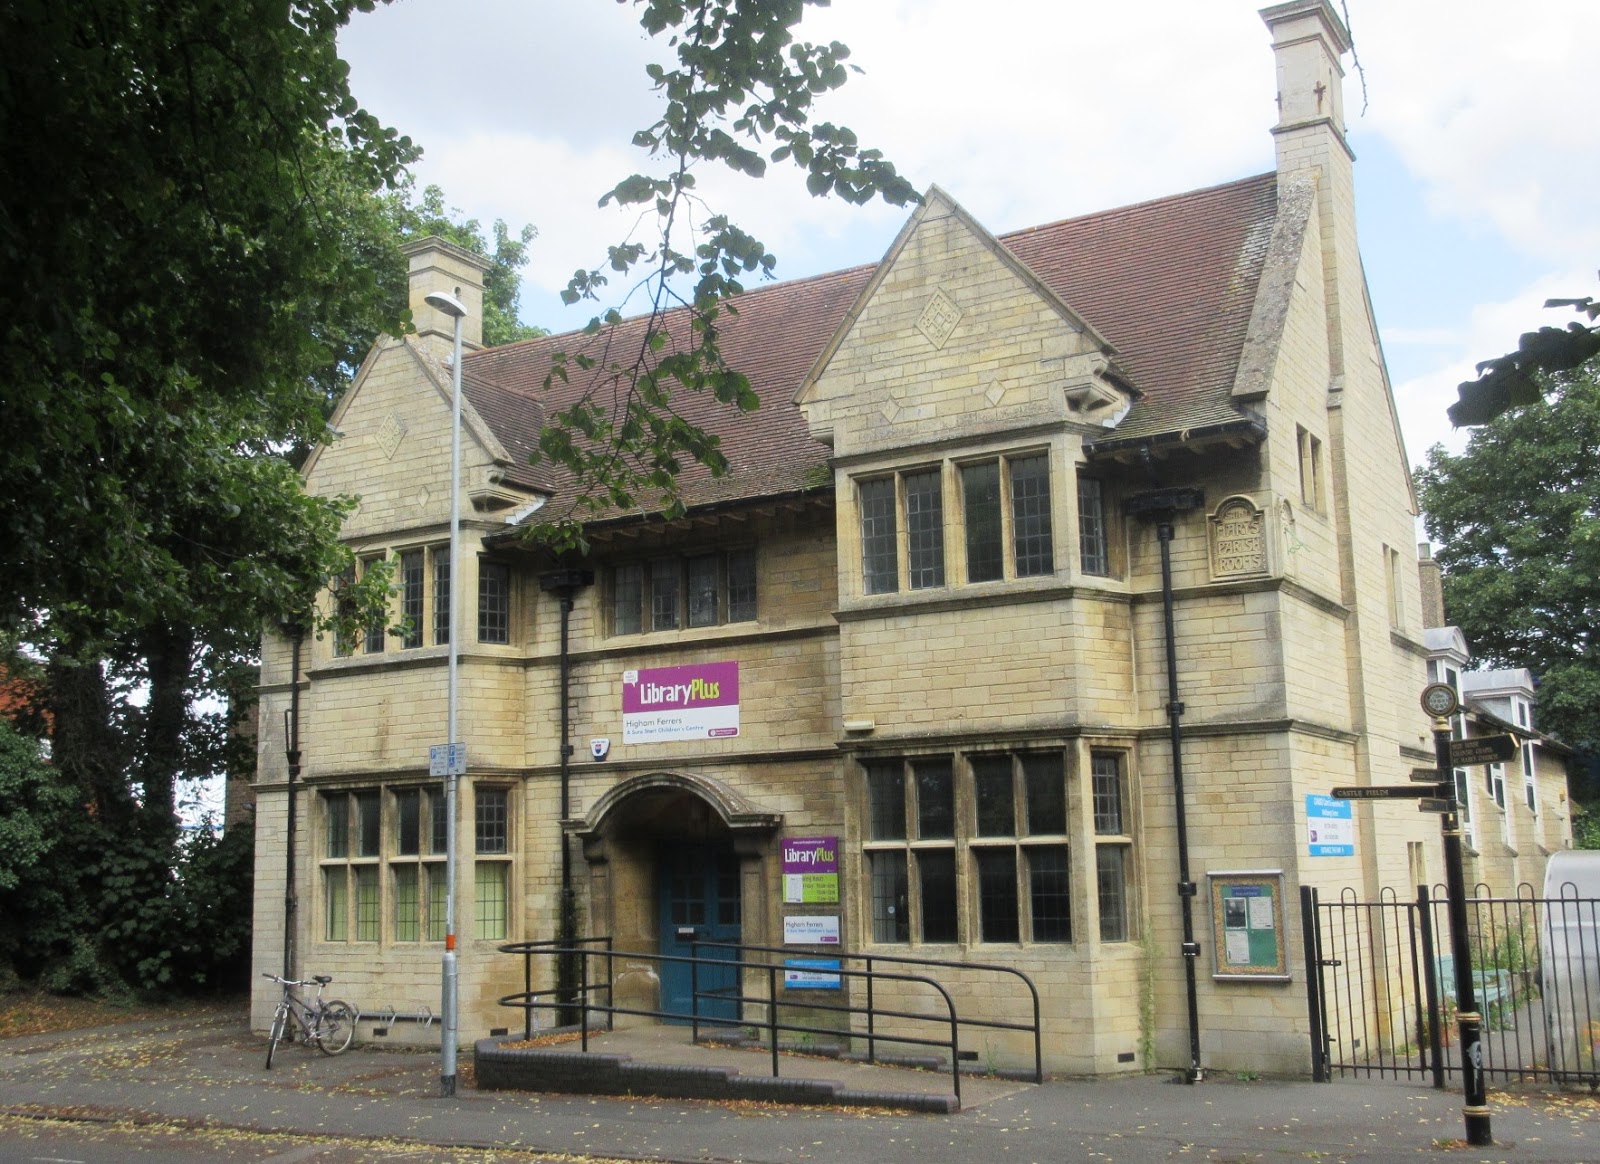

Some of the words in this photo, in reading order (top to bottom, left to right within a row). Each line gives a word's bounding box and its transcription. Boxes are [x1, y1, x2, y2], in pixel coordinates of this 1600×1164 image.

[640, 678, 720, 705] LibraryPlus
[626, 719, 655, 729] Higham
[657, 717, 683, 726] Ferrers
[785, 847, 834, 865] LibraryPlus
